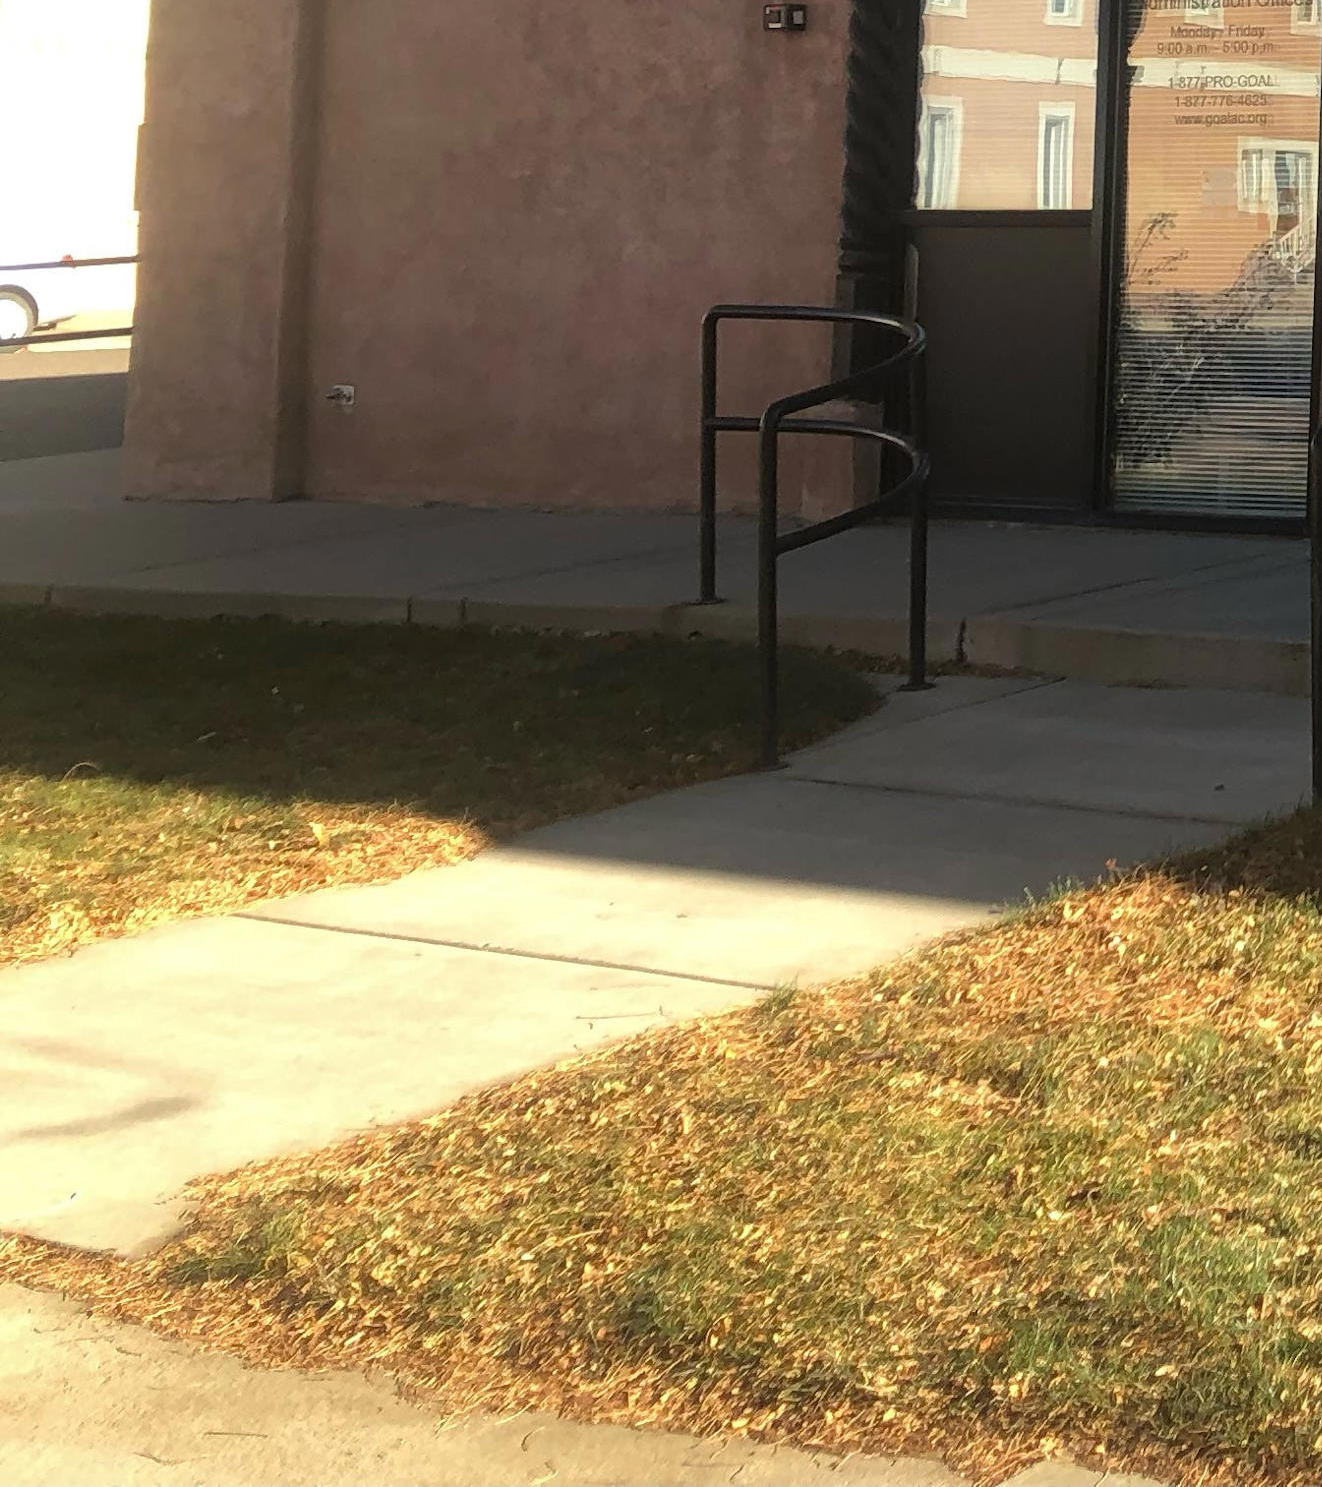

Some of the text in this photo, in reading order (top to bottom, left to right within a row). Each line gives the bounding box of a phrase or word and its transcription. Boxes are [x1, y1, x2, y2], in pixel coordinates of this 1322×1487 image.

[1170, 25, 1216, 40] Monday
[1228, 24, 1266, 39] Friday
[1168, 74, 1275, 89] 1-877-PRO-GOAL
